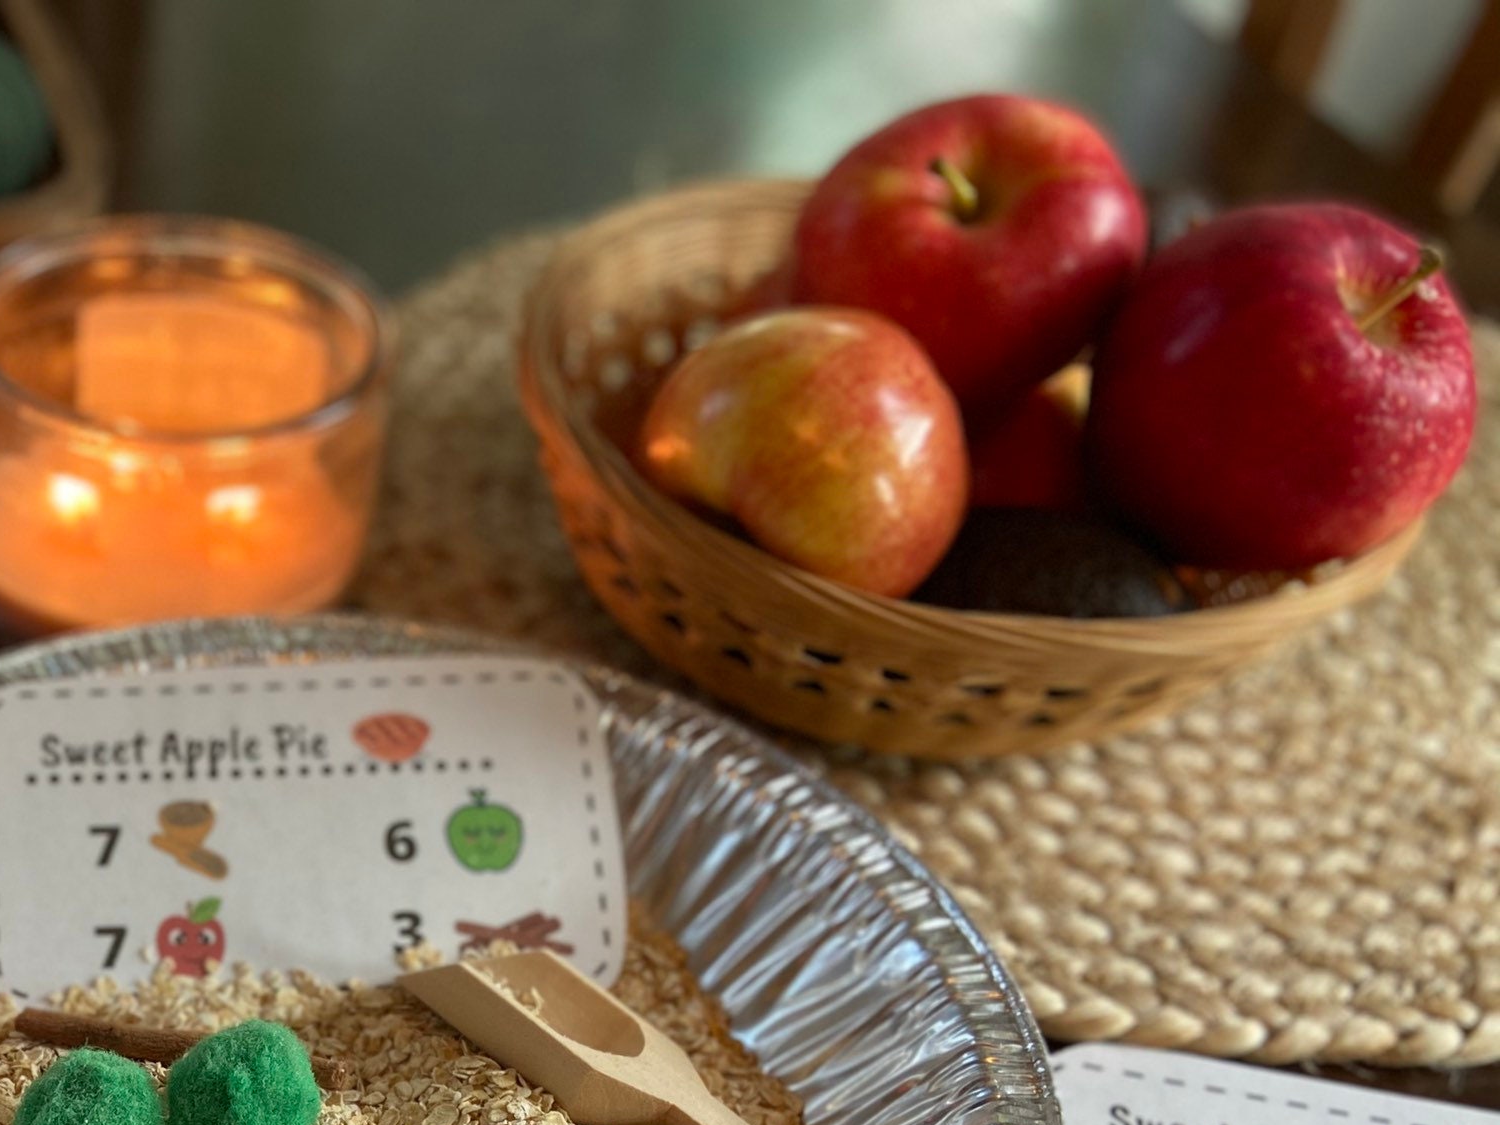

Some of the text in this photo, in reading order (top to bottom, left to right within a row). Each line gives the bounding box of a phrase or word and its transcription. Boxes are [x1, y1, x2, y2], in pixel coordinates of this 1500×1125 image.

[41, 723, 329, 779] Sweet Apple Pie
[89, 826, 121, 867] 7
[384, 821, 417, 862] 6
[94, 926, 127, 969] 7
[392, 909, 423, 954] 3
